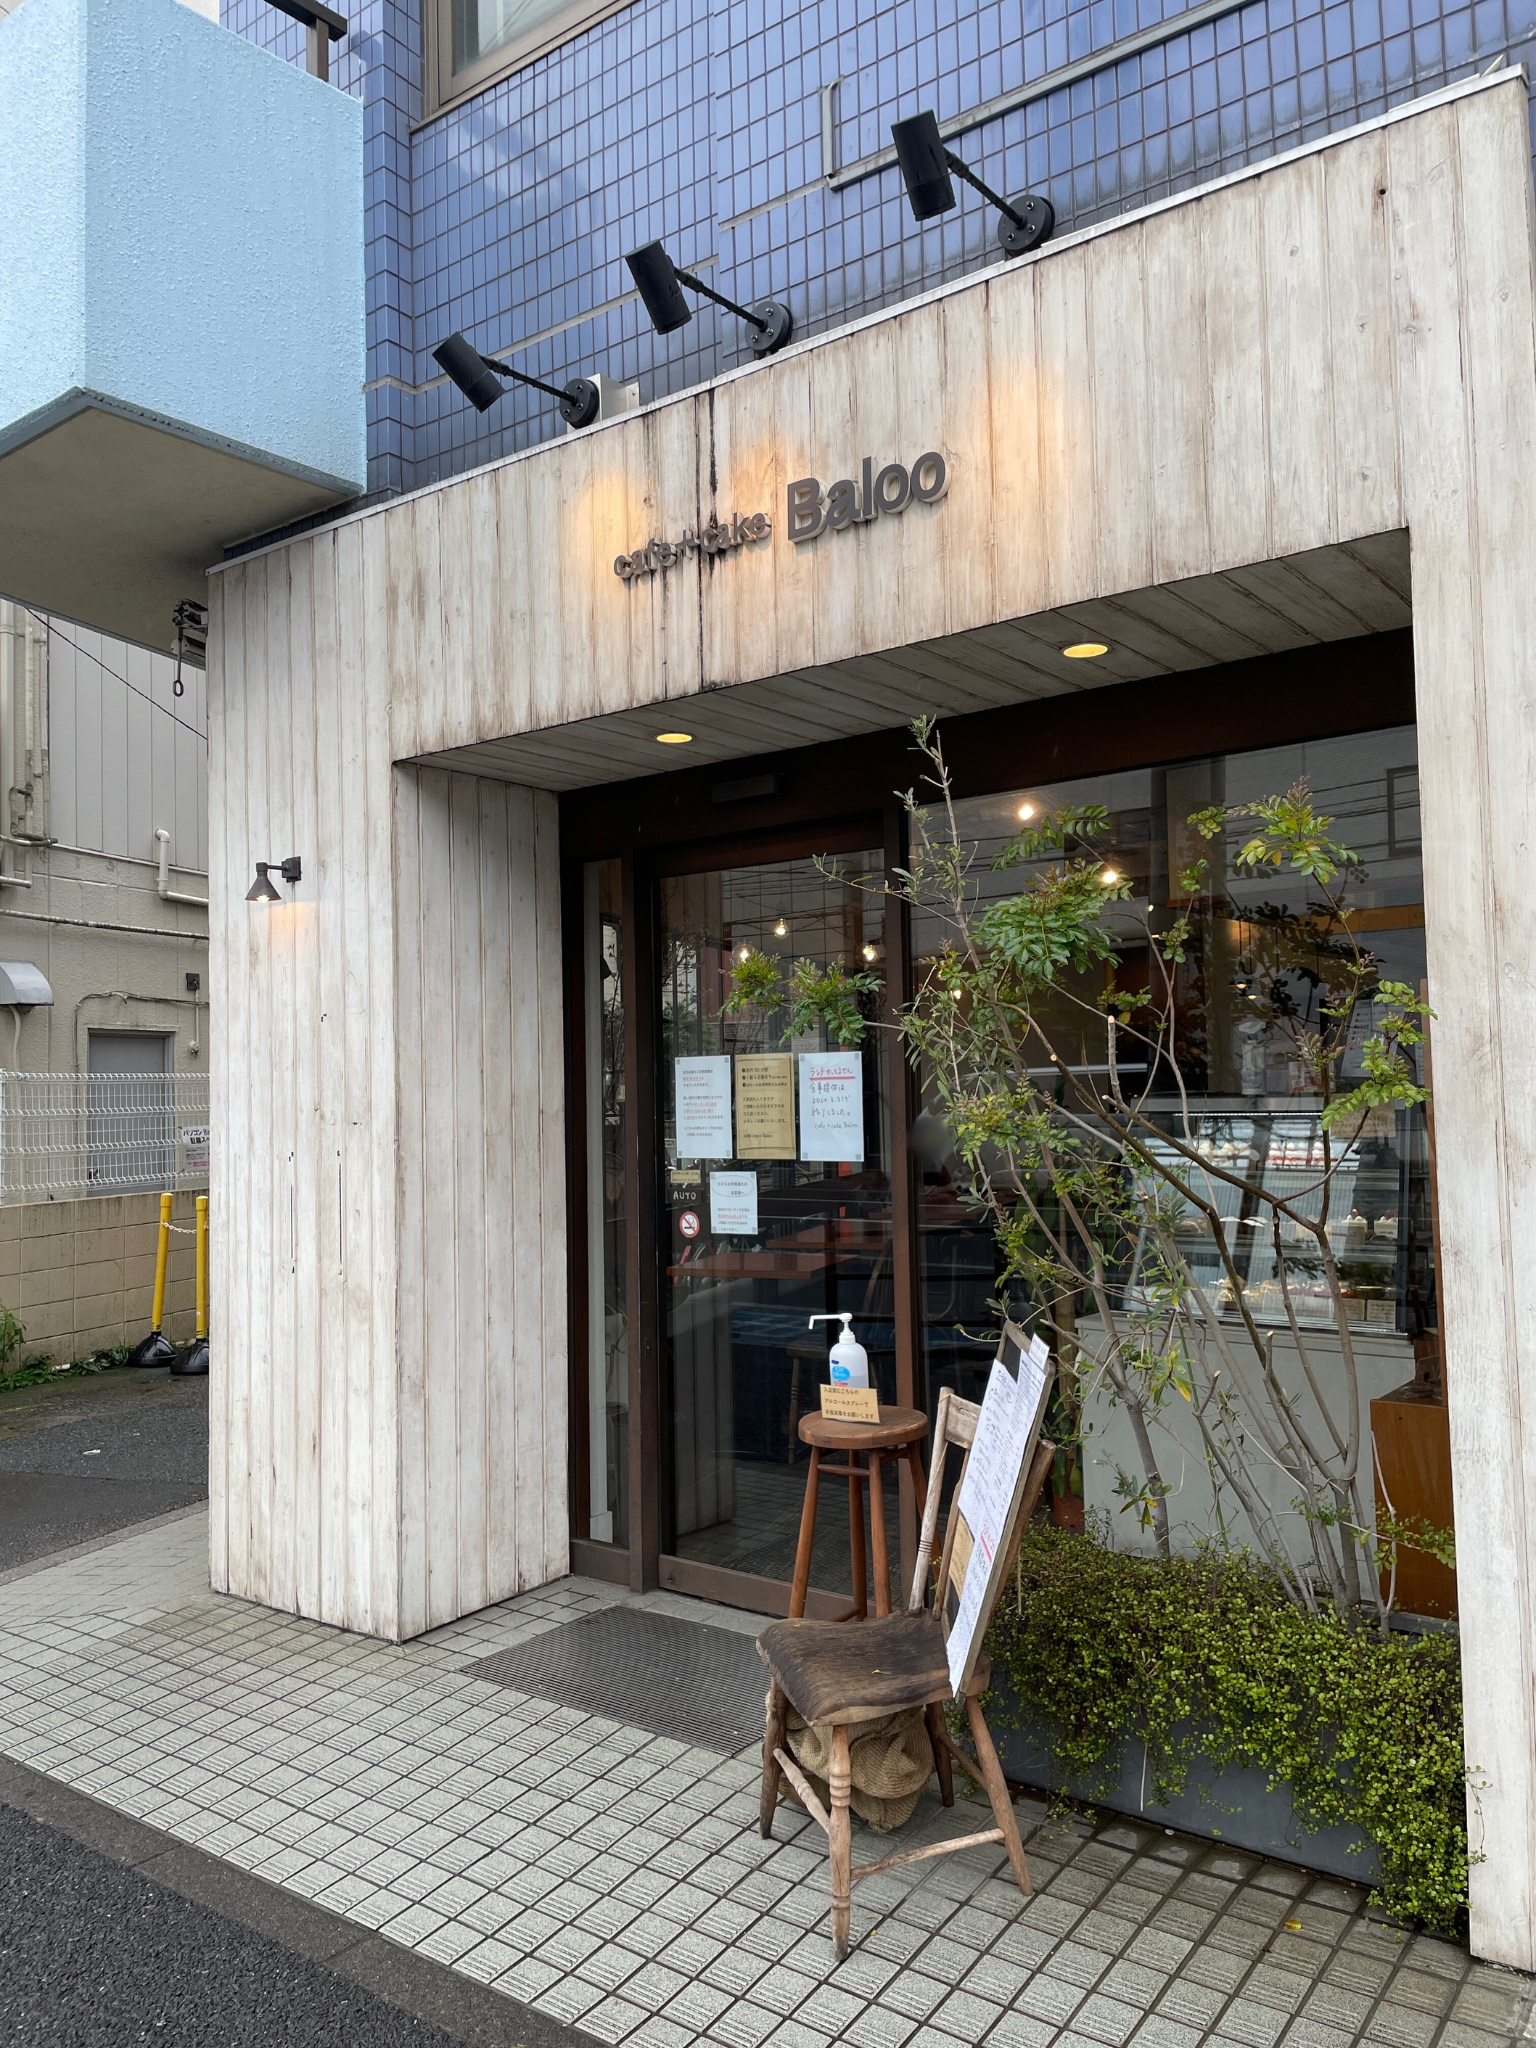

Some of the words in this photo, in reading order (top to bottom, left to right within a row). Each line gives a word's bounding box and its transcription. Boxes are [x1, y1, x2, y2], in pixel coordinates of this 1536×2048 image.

[786, 451, 952, 543] Baloo
[673, 1190, 697, 1200] AUTO
[825, 1399, 869, 1407] アルコールスプレーで
